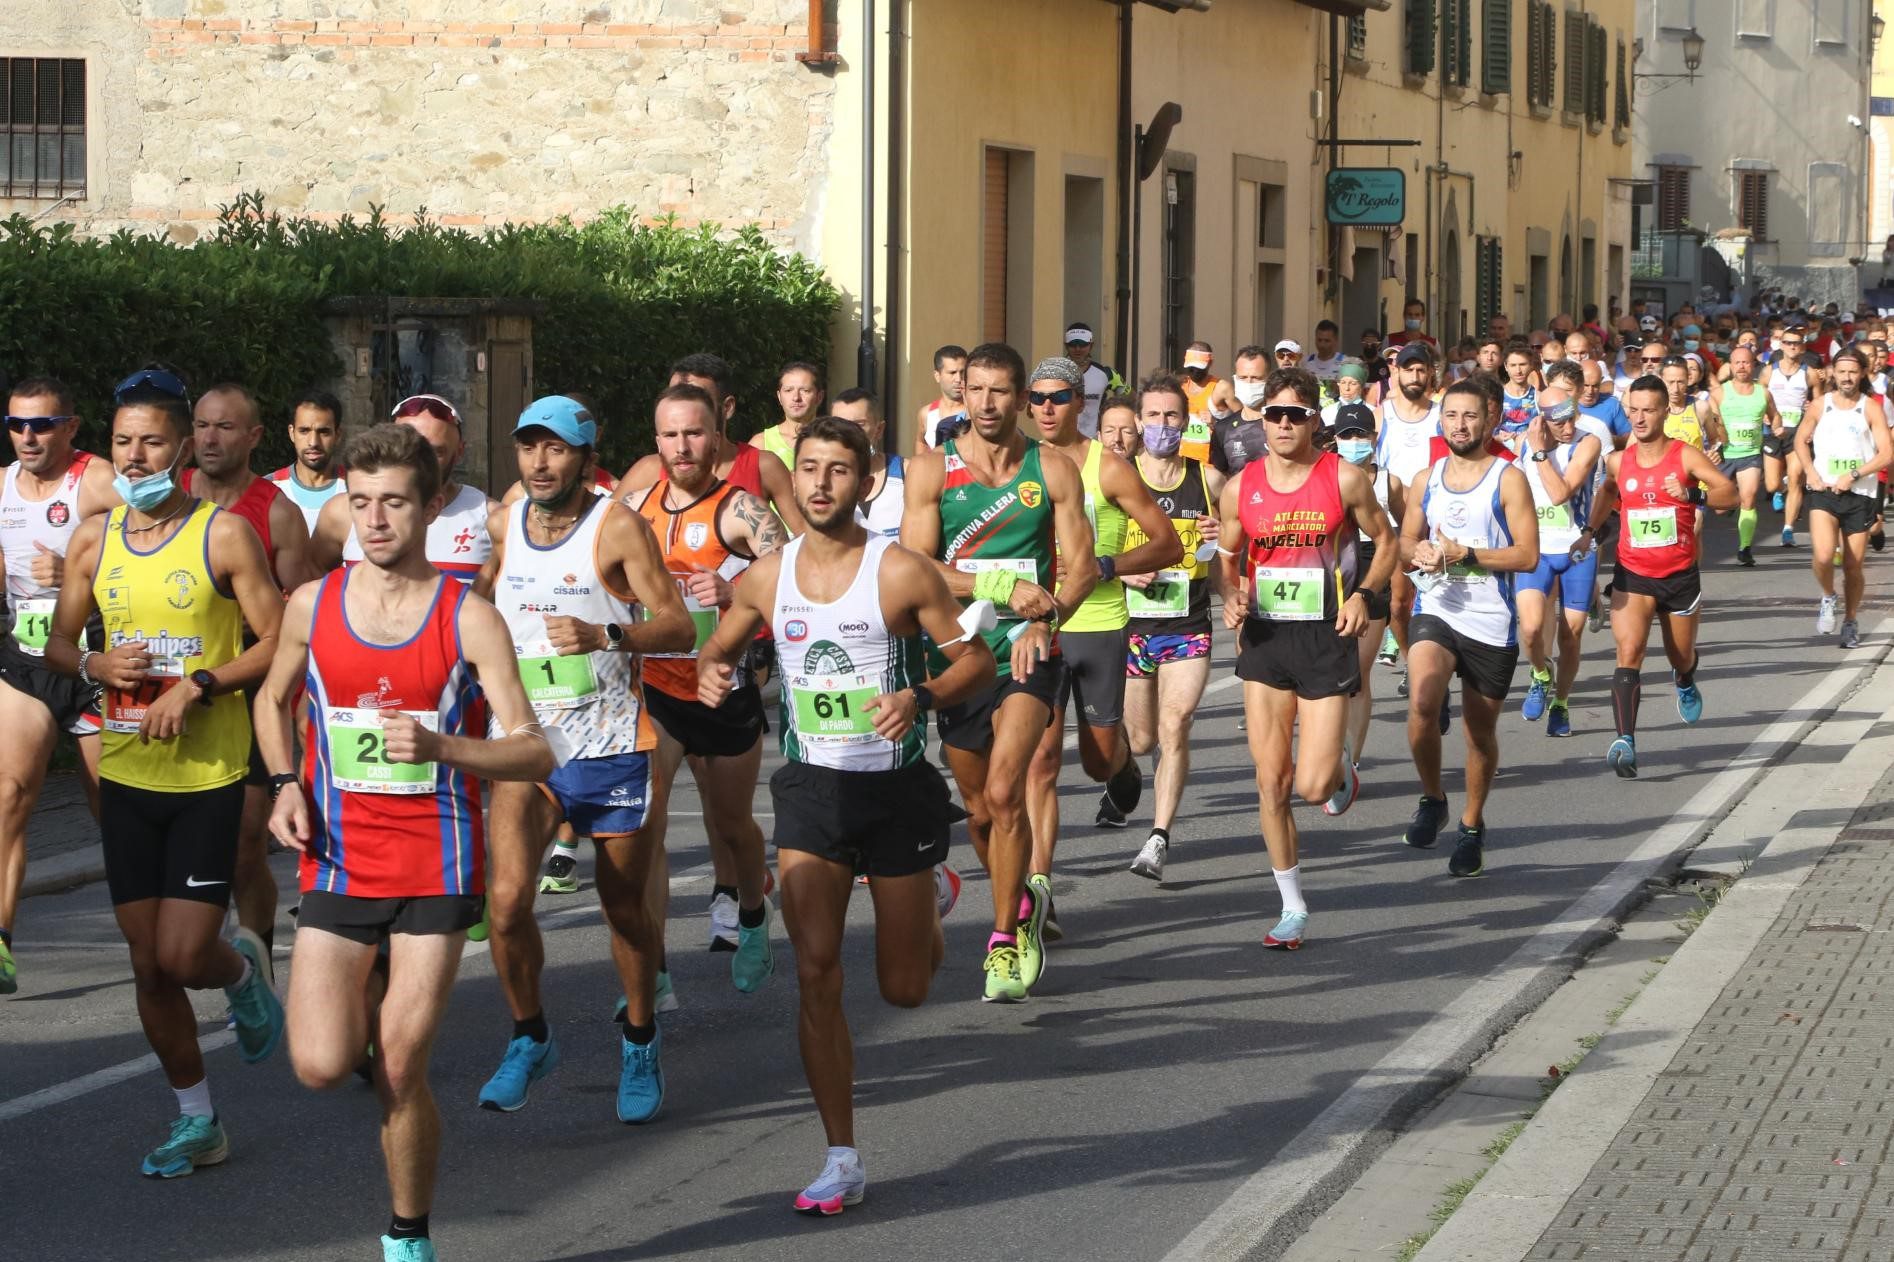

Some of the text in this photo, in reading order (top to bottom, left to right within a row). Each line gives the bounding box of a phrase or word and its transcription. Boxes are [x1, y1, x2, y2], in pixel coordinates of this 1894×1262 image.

[1190, 424, 1203, 434] 13
[1736, 429, 1754, 438] 105
[1833, 459, 1857, 470] 118
[980, 491, 1018, 522] ELLERA
[1274, 510, 1325, 522] ATLETICA
[1272, 523, 1327, 533] MARCIATORI
[1640, 520, 1661, 535] 75
[1254, 533, 1327, 550] MUGELLO
[1273, 581, 1302, 601] 47
[519, 603, 558, 612] POLAR
[843, 623, 866, 632] MOEL
[540, 660, 555, 685] 1
[792, 676, 809, 687] ACS
[813, 693, 850, 719] 61
[115, 708, 123, 719] EL
[329, 711, 353, 723] ACS
[820, 720, 854, 731] DI PARDO
[367, 766, 392, 779] CASSI
